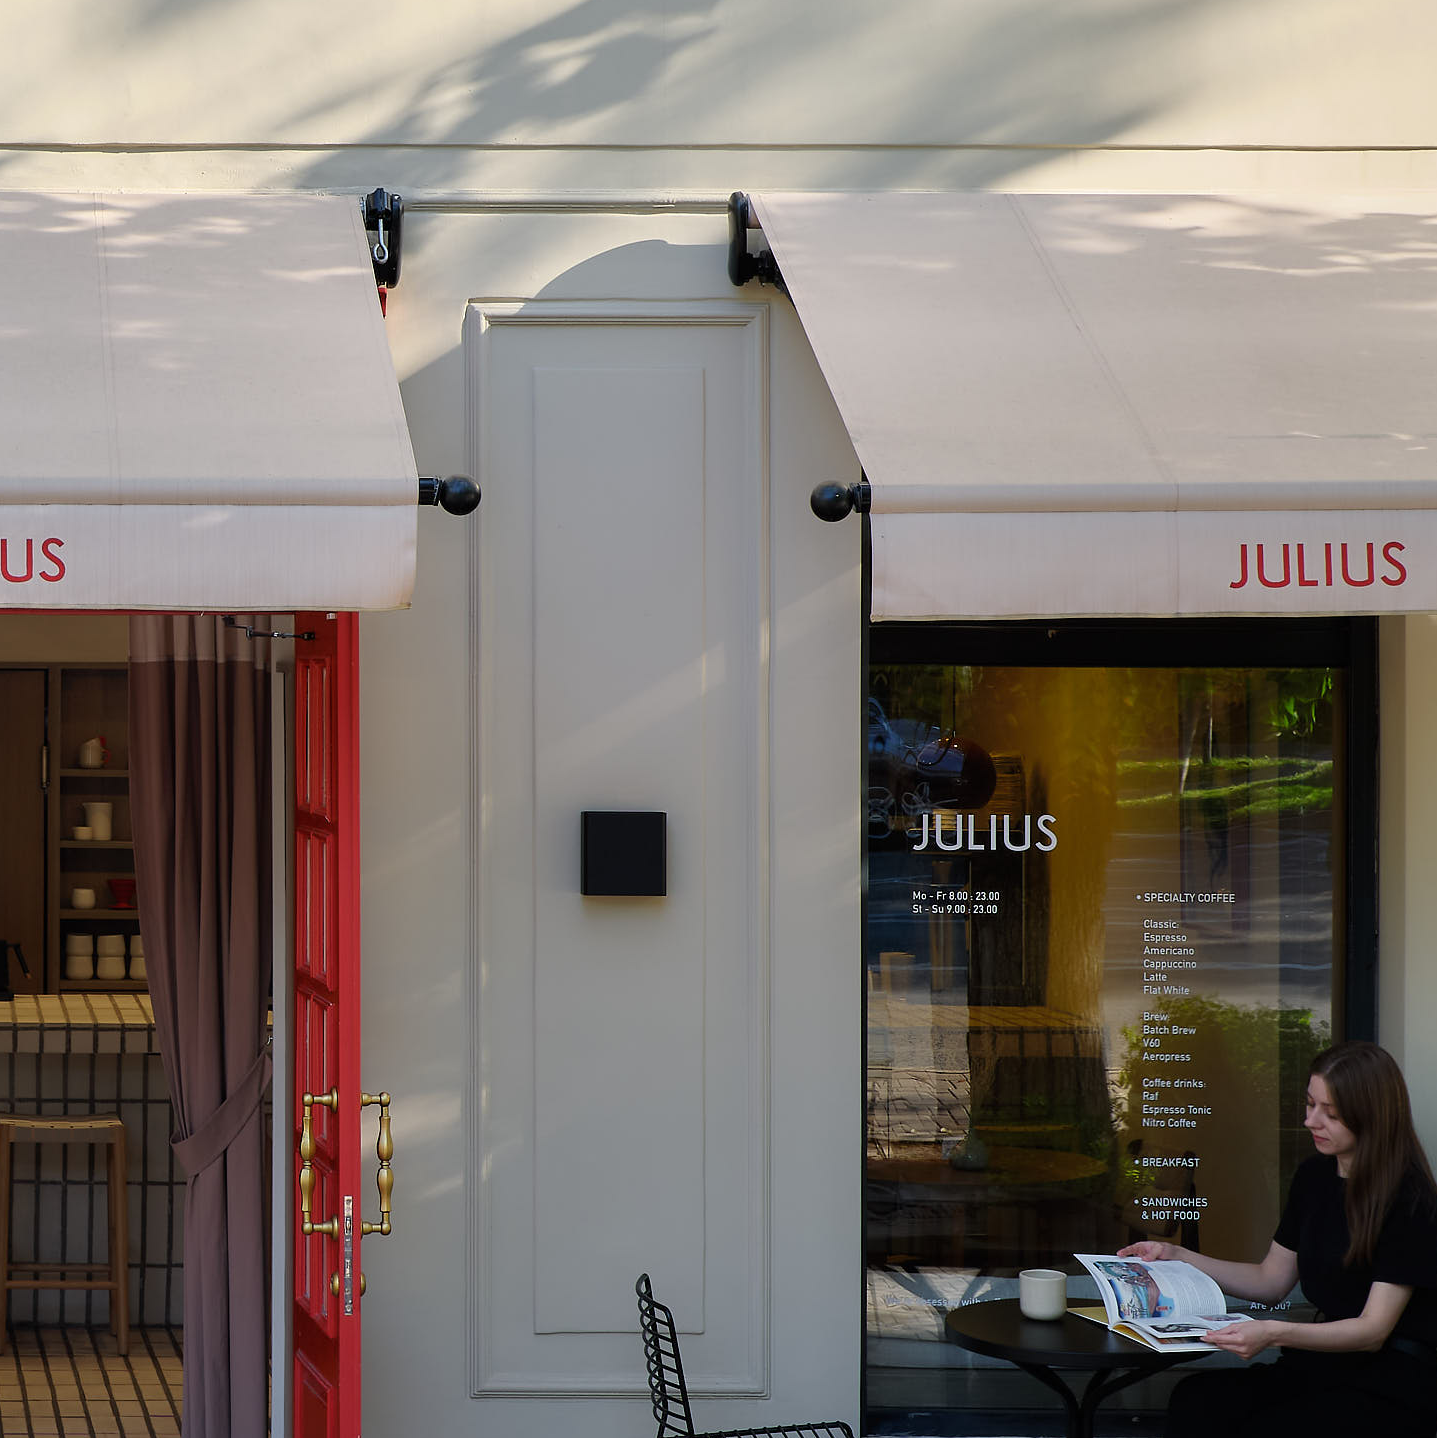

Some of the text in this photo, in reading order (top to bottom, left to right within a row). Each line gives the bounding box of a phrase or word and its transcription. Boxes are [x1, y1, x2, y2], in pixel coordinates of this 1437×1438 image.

[1229, 540, 1408, 589] JULIUS
[912, 813, 1058, 852] JULIUS
[912, 891, 927, 901] Mo
[936, 891, 947, 901] Fr
[948, 891, 968, 901] 8.00
[975, 891, 1000, 901] 23.00
[1144, 893, 1236, 903] SPECIALTY COFFEE
[912, 904, 923, 914] St
[931, 904, 944, 914] Su
[946, 904, 966, 914] 9.00
[973, 904, 998, 914] 23.00
[1143, 932, 1187, 943] Espresso
[1143, 945, 1195, 955] Americano
[1143, 959, 1197, 970] Cappuccino
[1143, 972, 1167, 981] Latte
[1143, 985, 1190, 995] Flat White
[1143, 1025, 1197, 1035] Batch Brew
[1142, 1038, 1161, 1048] V60
[1142, 1052, 1191, 1062] Aeropress
[1142, 1078, 1172, 1088] Coffee
[1142, 1091, 1160, 1101] Raf
[1142, 1105, 1212, 1116] Espresso Tonic
[1142, 1118, 1197, 1128] Nitro Coffee
[1142, 1157, 1201, 1167] BREAKFAST
[1141, 1197, 1208, 1207] SANDWICHES
[1141, 1210, 1201, 1220] & HOT FOOD
